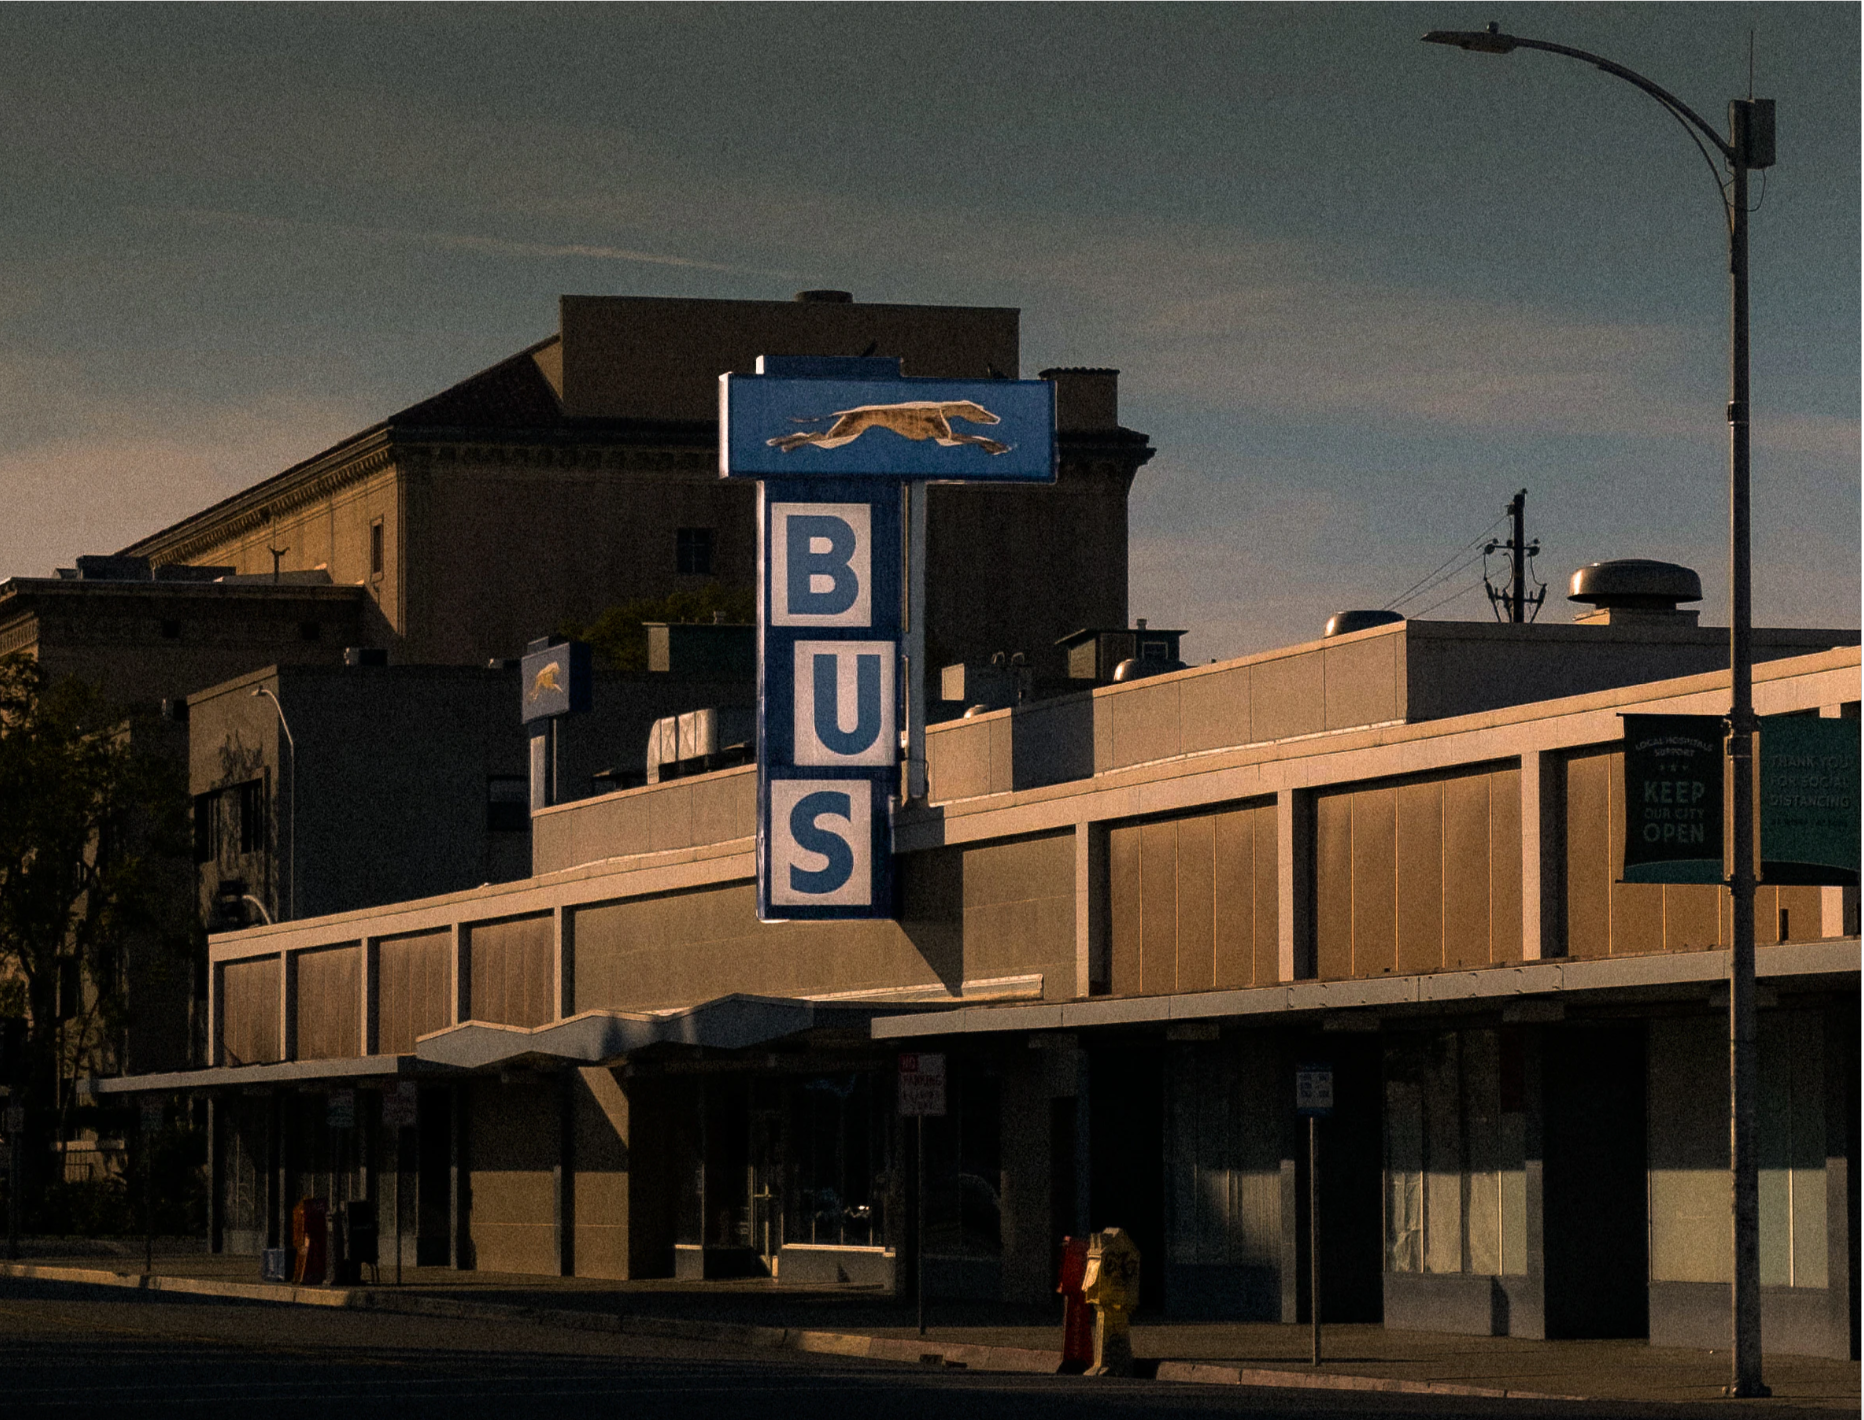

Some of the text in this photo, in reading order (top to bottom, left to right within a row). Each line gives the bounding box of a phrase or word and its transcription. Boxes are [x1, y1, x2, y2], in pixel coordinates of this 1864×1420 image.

[787, 515, 882, 895] BUS
[1635, 737, 1663, 751] LOCAL
[1771, 755, 1850, 768] THANK YOU
[1771, 774, 1849, 788] FOR SOCIAL
[1643, 780, 1705, 804] KEEP
[1770, 794, 1851, 808] DISTANCING
[1643, 806, 1704, 819] OUR CITY
[1643, 822, 1704, 843] OPEN
